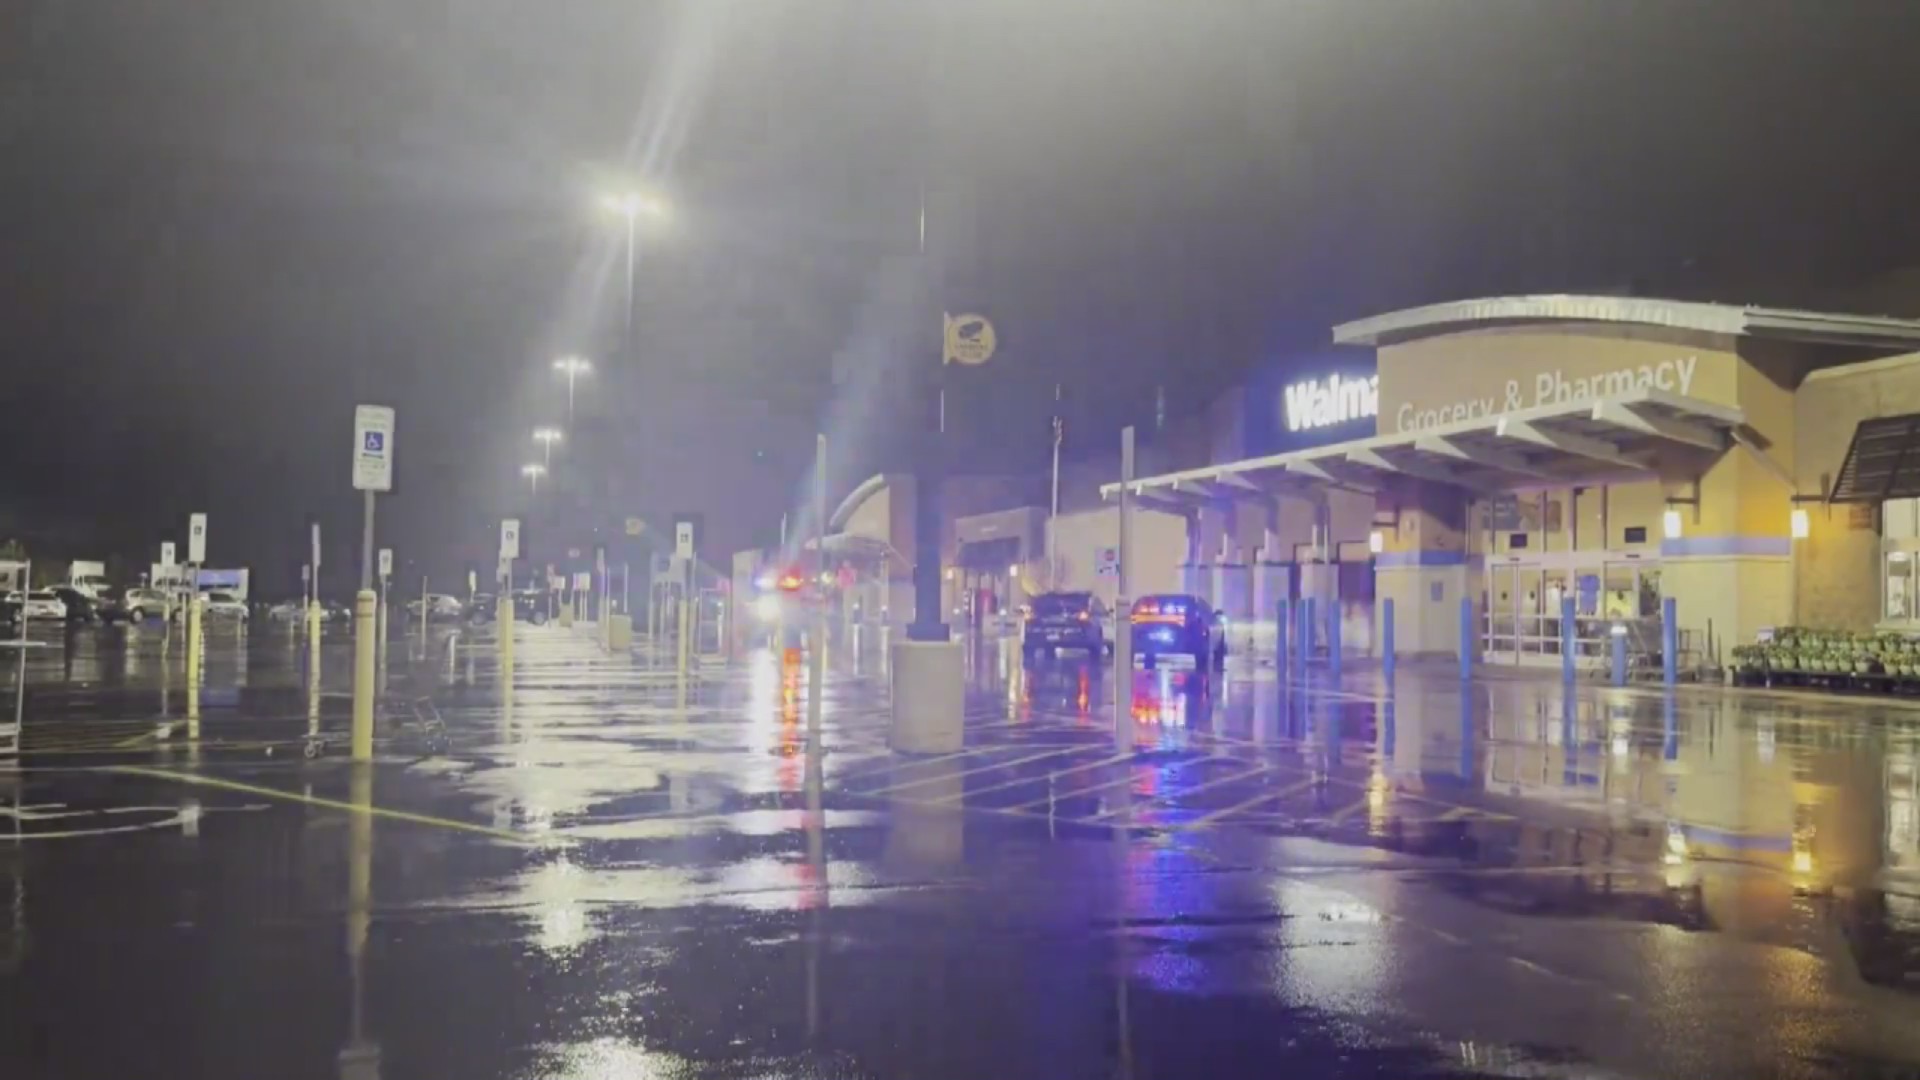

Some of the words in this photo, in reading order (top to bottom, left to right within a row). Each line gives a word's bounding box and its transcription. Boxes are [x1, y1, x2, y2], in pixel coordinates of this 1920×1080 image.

[1397, 397, 1495, 433] Grocery
[1504, 379, 1523, 413] &
[1535, 356, 1697, 408] Pharmacy
